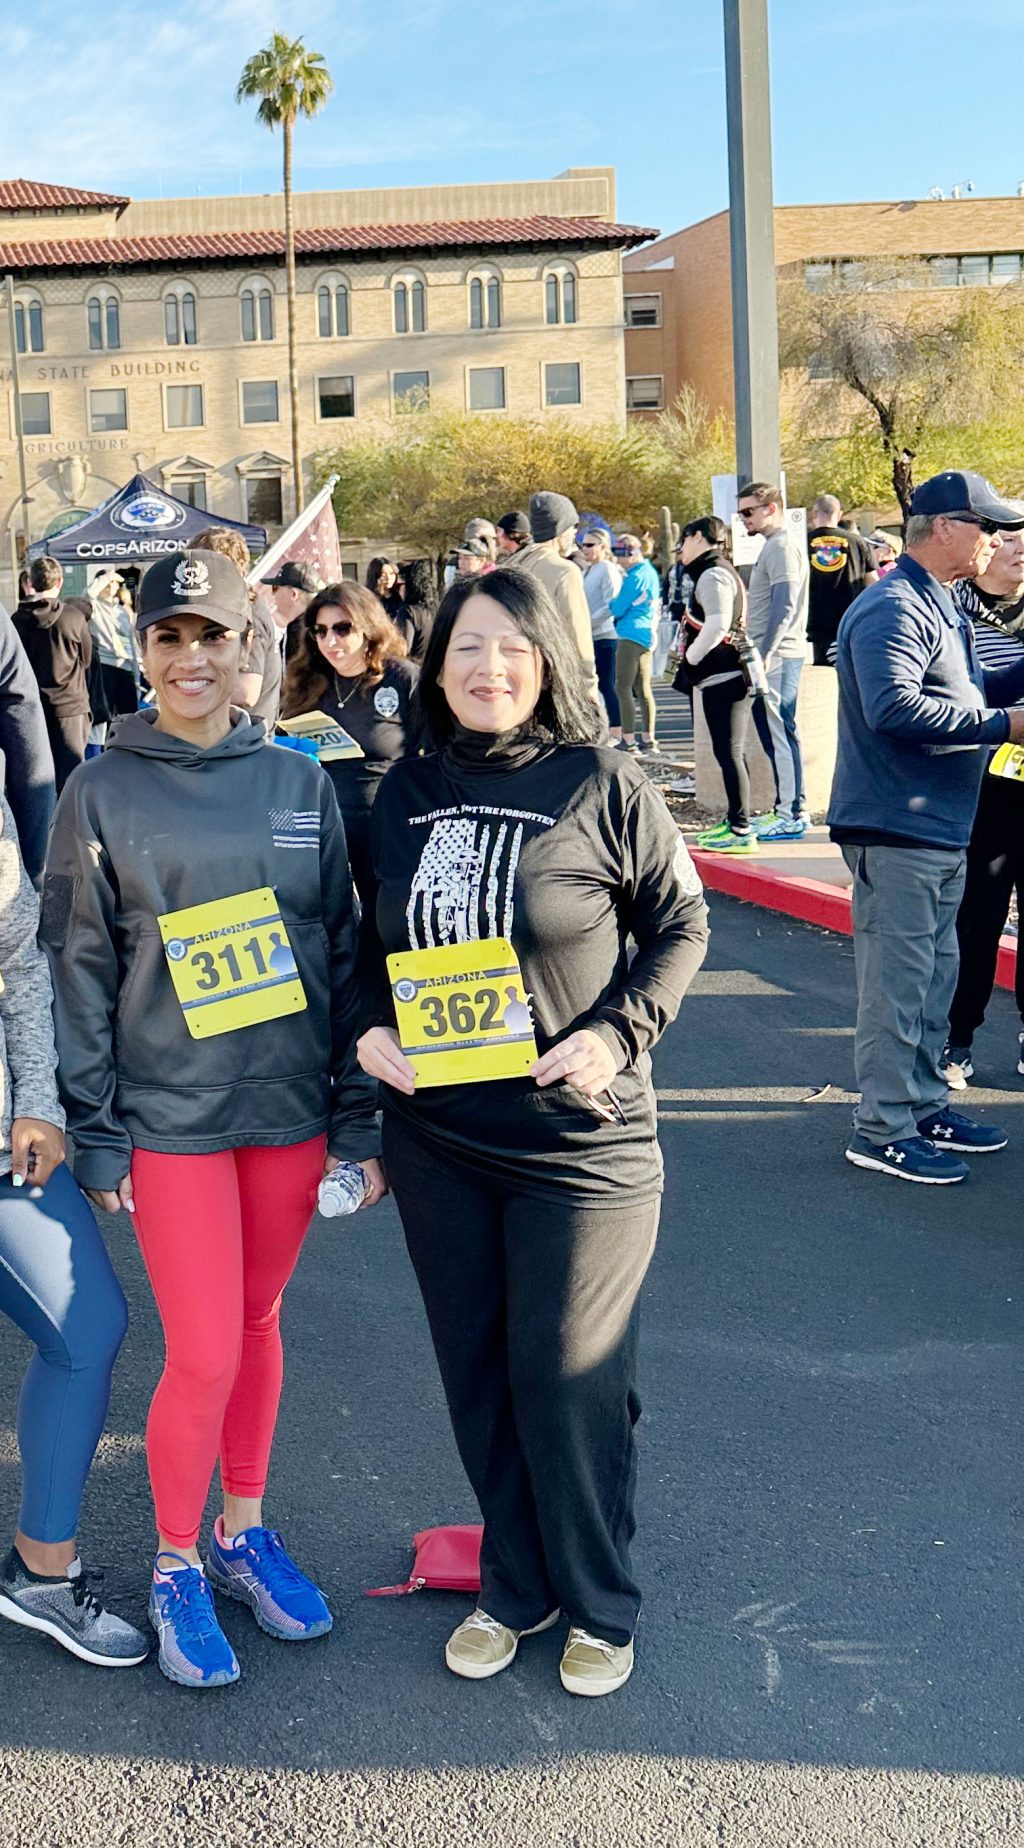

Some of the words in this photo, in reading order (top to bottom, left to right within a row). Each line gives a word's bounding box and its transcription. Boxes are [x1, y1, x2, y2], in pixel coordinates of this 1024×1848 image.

[37, 366, 90, 380] STATE
[110, 360, 201, 377] BUILDING
[18, 438, 129, 455] GRICULTURE
[307, 732, 342, 746] 20
[408, 815, 427, 825] THE
[478, 805, 499, 815] THE
[499, 807, 557, 827] FORGOTTEN
[194, 921, 253, 944] ARIZONA
[191, 937, 268, 991] 311
[425, 970, 487, 988] ARIZONA
[420, 988, 506, 1038] 362
